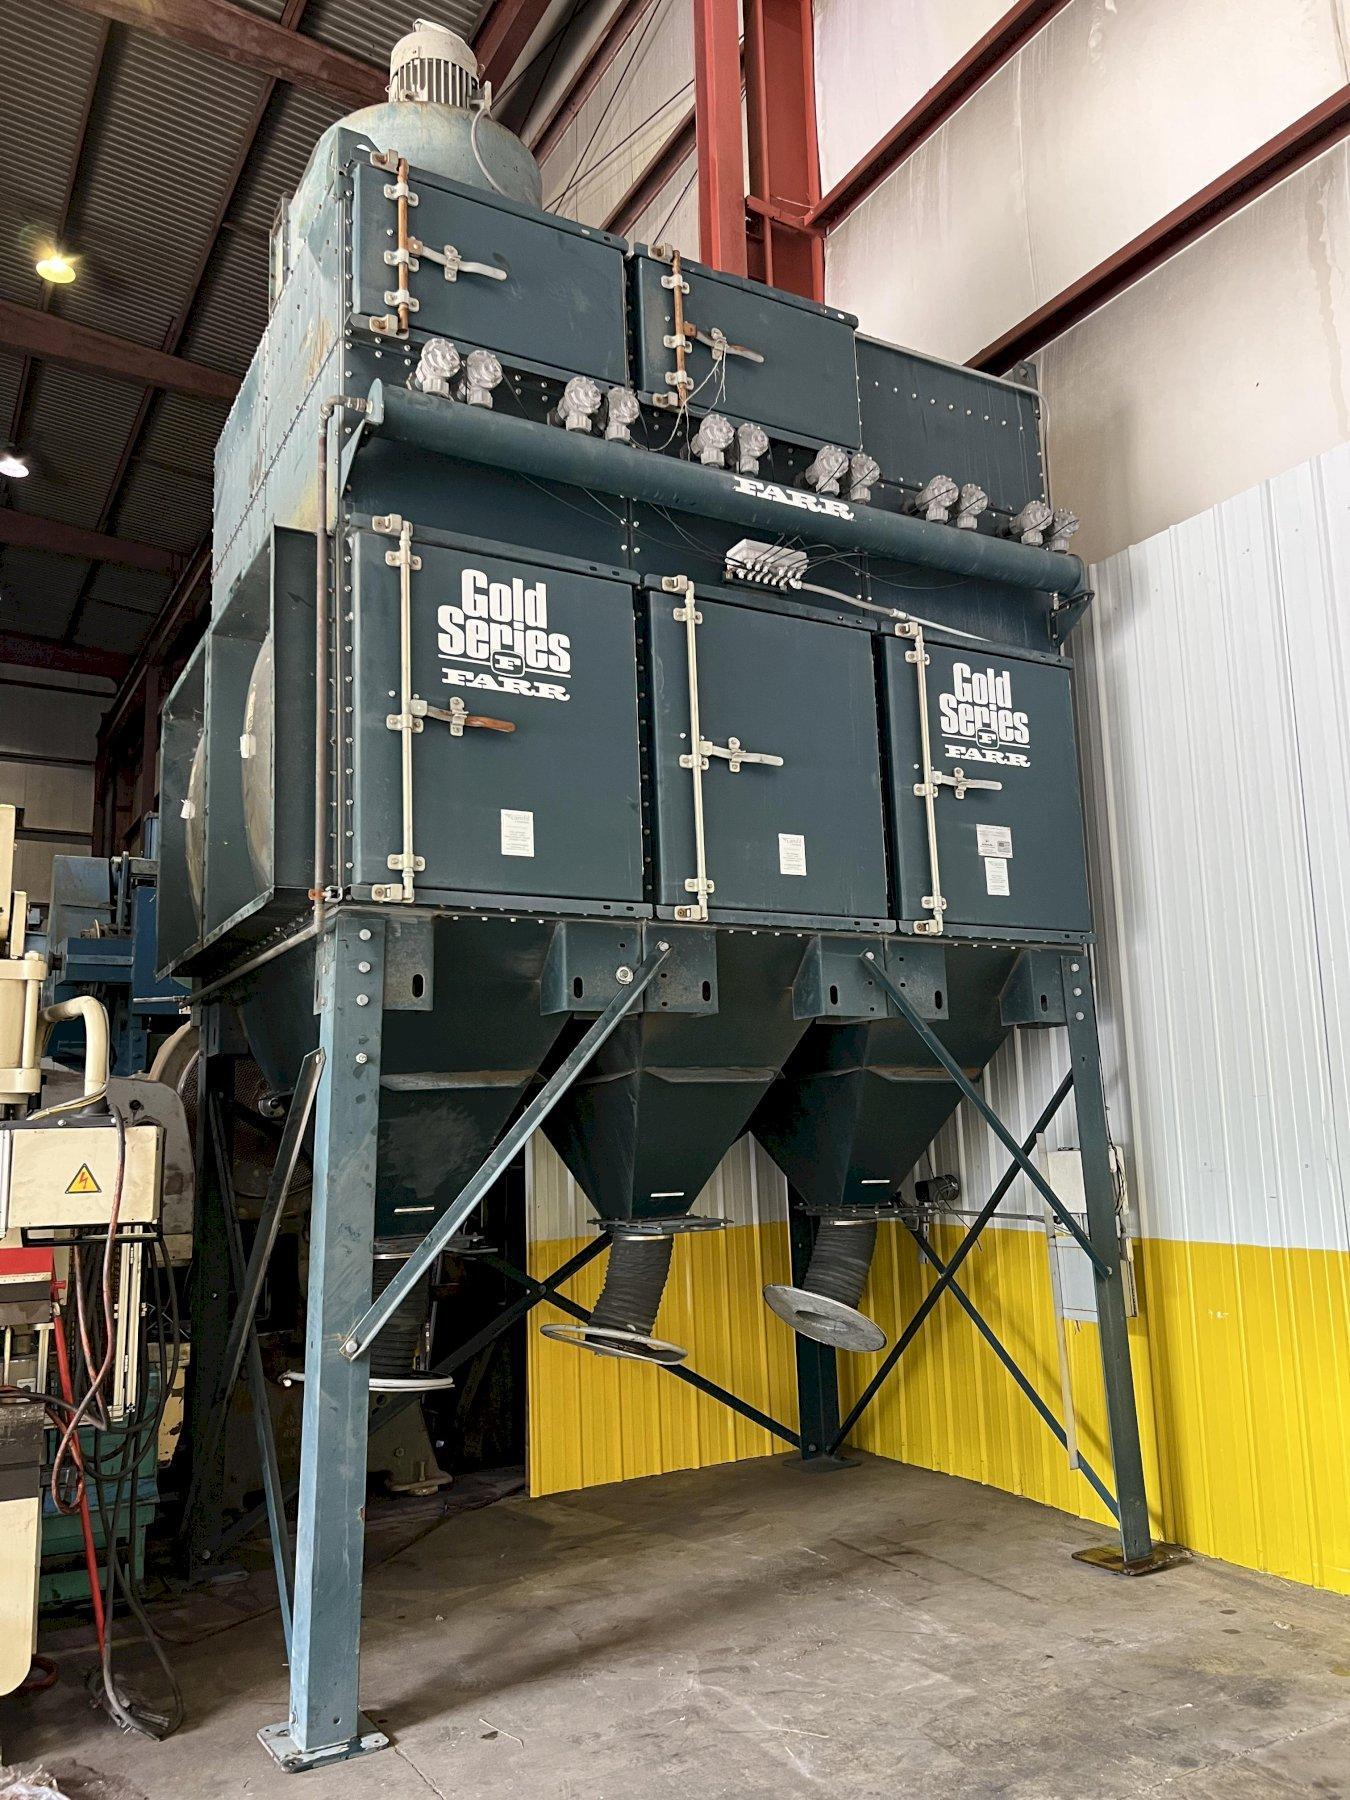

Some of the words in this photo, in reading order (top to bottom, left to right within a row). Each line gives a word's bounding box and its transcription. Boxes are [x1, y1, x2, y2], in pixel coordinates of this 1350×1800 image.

[732, 475, 855, 521] FARR
[461, 568, 548, 629] Gold
[437, 604, 571, 673] Series
[441, 667, 571, 702] FARR
[952, 662, 1013, 709] Gold
[938, 692, 1030, 744] Series
[944, 744, 1031, 768] FARR
